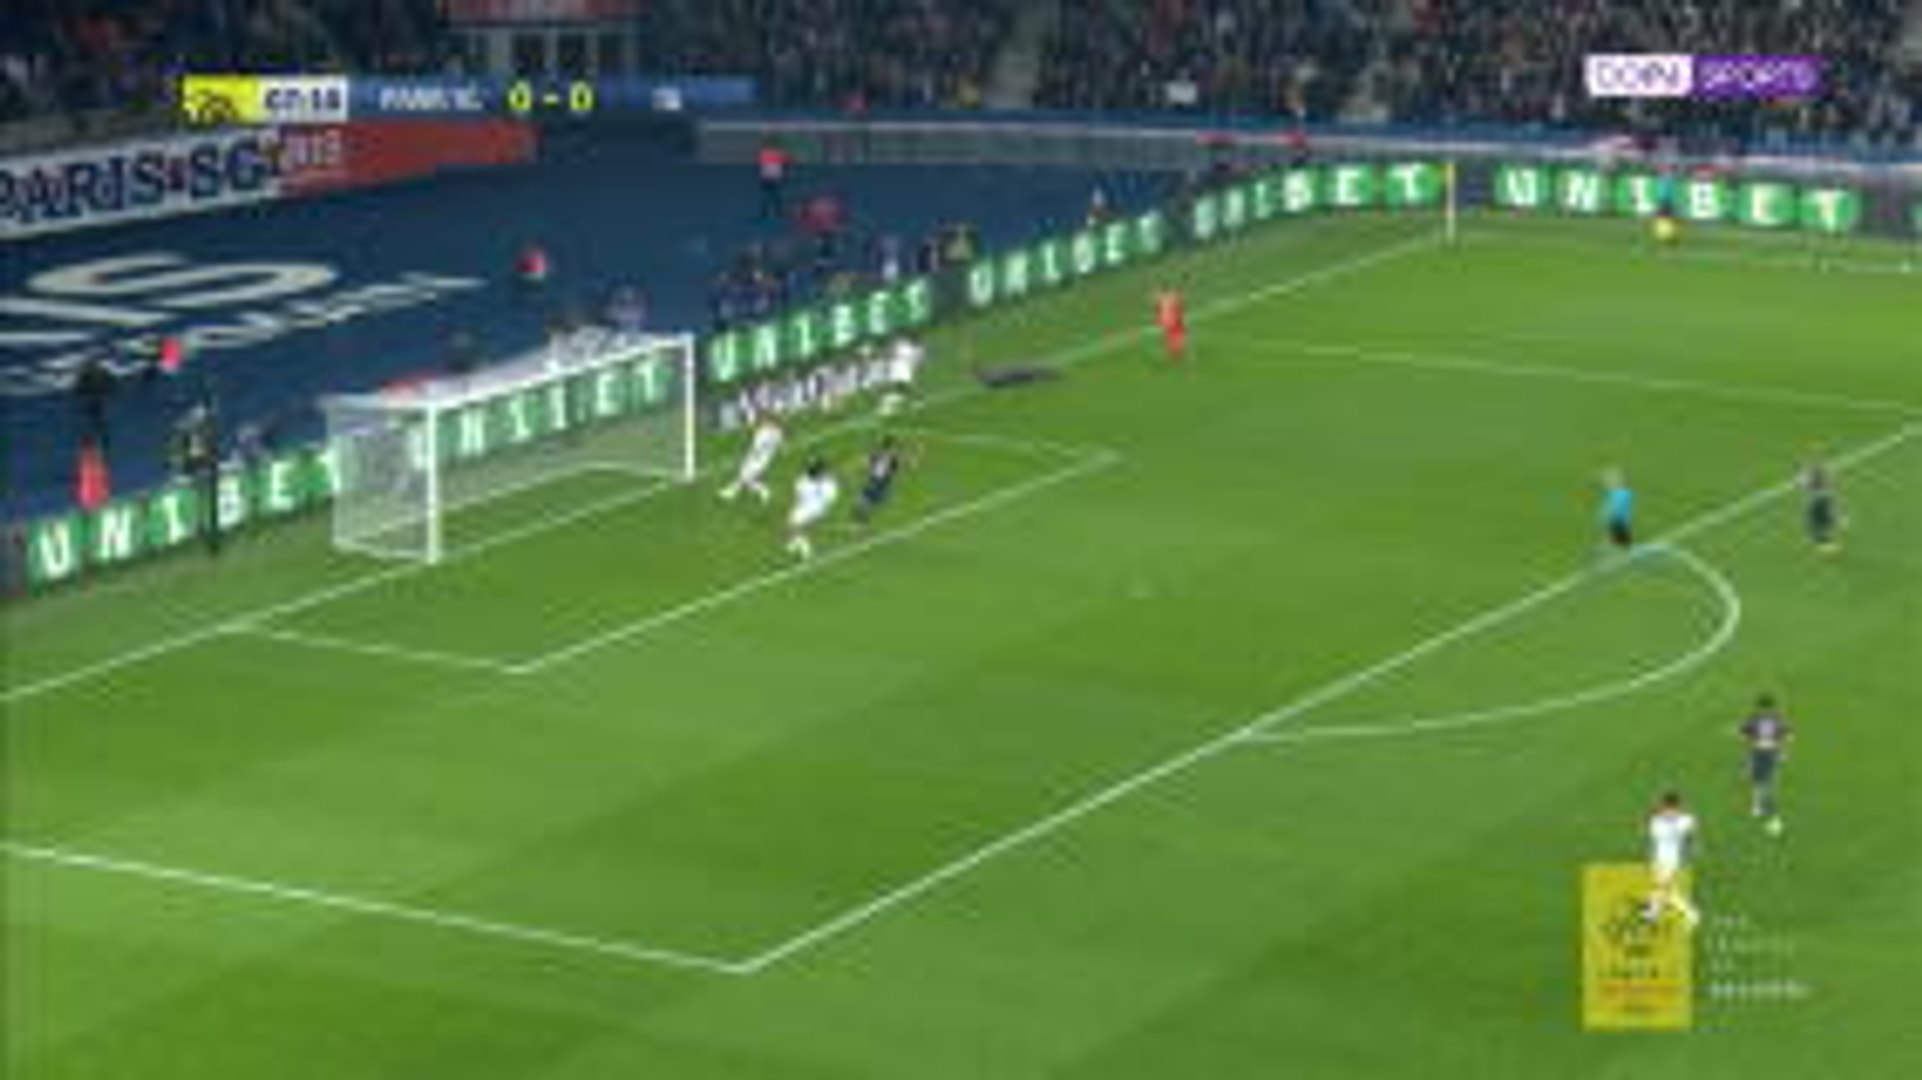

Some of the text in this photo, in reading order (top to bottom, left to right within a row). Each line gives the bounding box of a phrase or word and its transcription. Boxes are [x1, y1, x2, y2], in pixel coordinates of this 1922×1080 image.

[1506, 168, 1848, 233] UNIBET
[968, 208, 1165, 306] UNIBET
[710, 277, 928, 383] UNIBET
